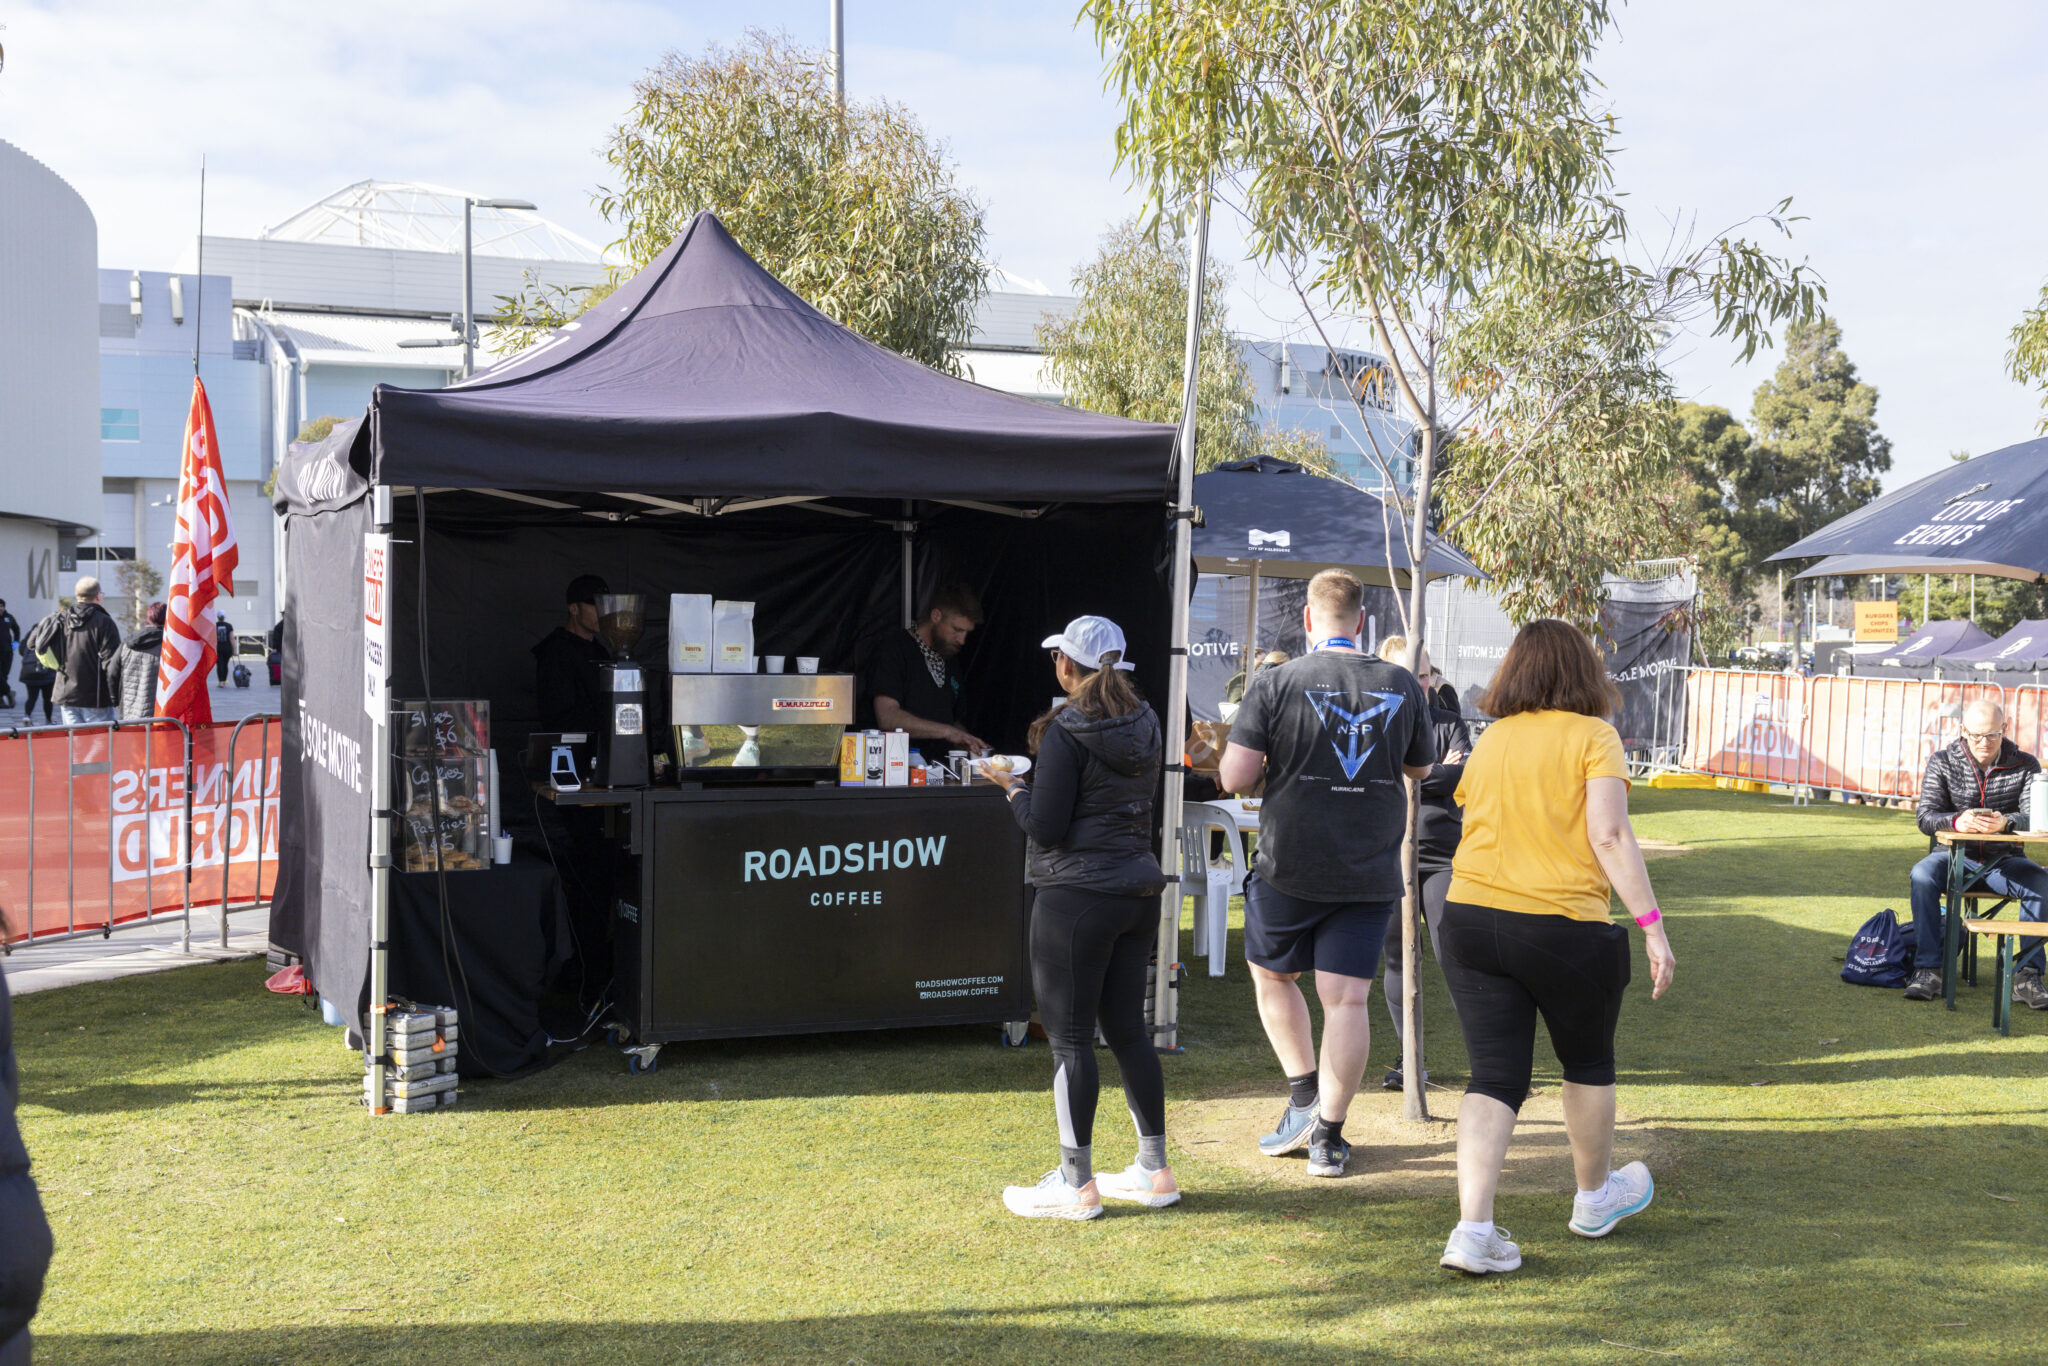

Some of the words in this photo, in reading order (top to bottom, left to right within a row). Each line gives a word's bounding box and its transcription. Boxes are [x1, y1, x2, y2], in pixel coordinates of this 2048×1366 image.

[1931, 501, 1995, 521] CITY
[1976, 499, 2025, 521] OF
[1893, 524, 1987, 545] EVENTS
[62, 554, 72, 569] 16
[1187, 642, 1239, 656] OTIVE
[435, 725, 458, 750] $6
[306, 714, 327, 768] SOLE
[328, 727, 362, 794] MOTIVE
[869, 746, 882, 754] LY!
[411, 766, 464, 785] Cokies
[411, 818, 467, 836] Pasries
[744, 835, 947, 883] ROADSHOW
[810, 891, 882, 906] COFFEE
[915, 975, 1004, 989] ROADSHOWCOFFEE.COM
